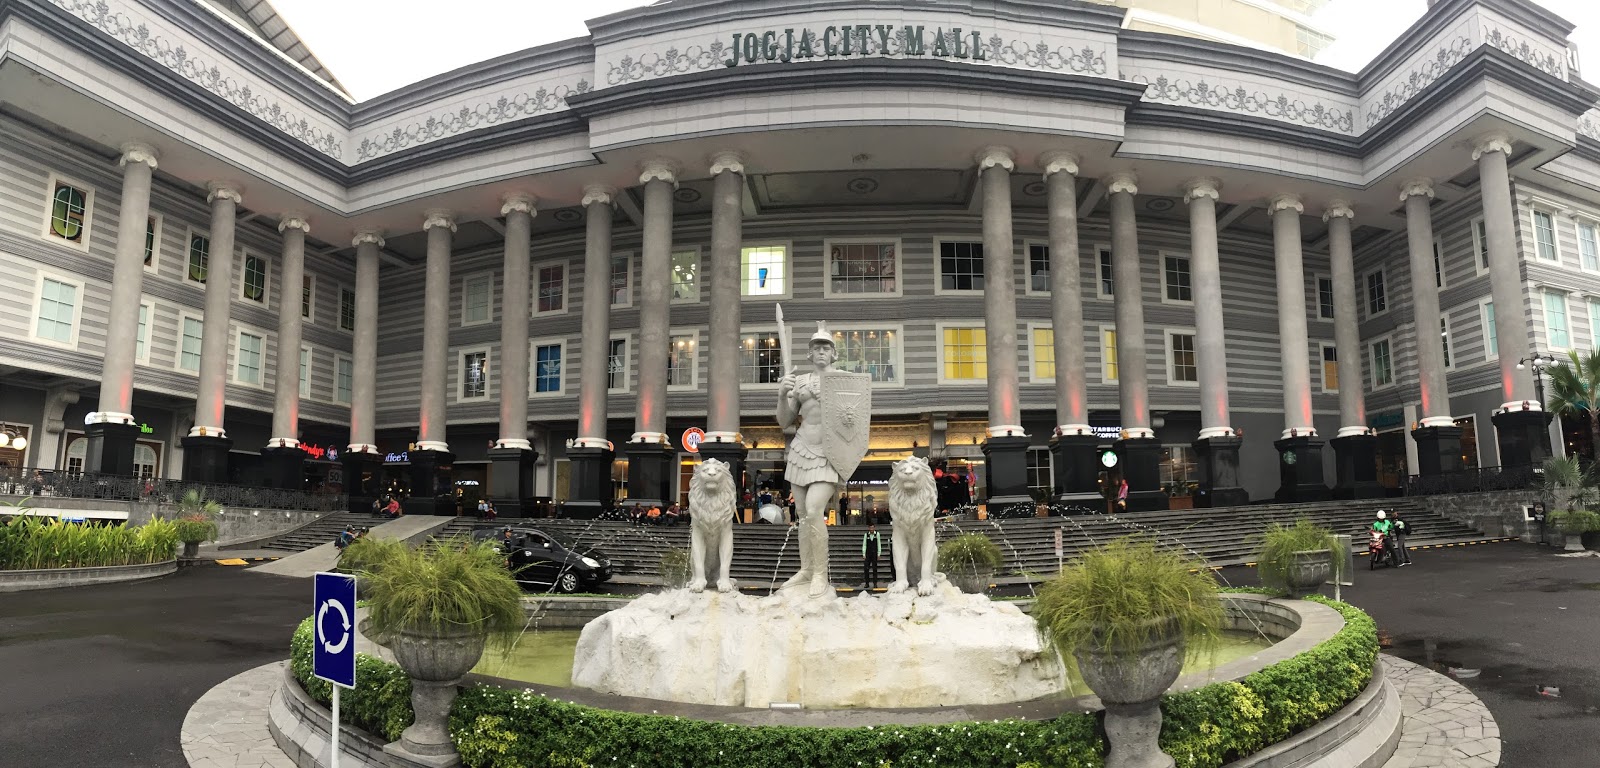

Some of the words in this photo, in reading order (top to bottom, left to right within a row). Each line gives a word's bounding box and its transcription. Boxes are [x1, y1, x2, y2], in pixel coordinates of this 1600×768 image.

[725, 28, 814, 67] JOGJA
[823, 25, 893, 57] CITY
[904, 25, 985, 60] MALL
